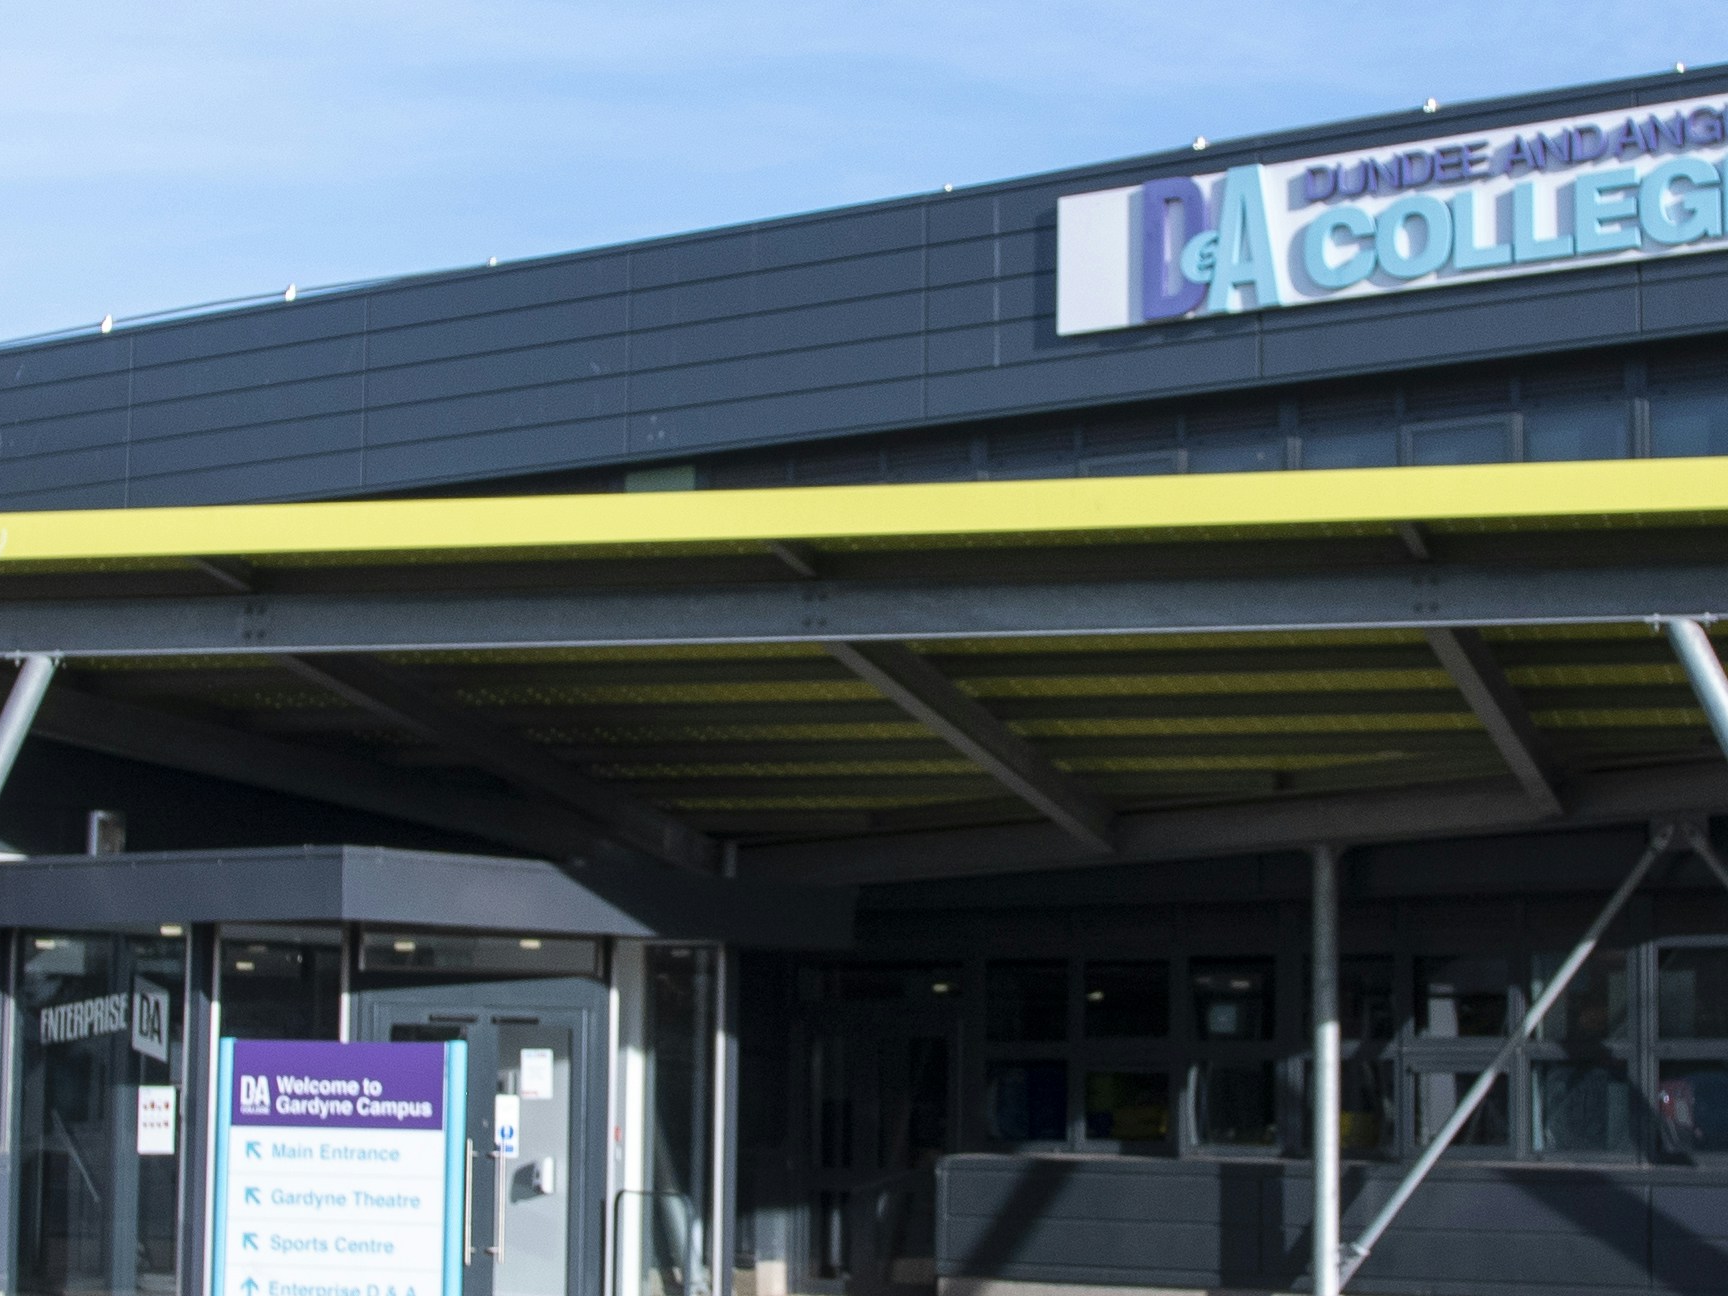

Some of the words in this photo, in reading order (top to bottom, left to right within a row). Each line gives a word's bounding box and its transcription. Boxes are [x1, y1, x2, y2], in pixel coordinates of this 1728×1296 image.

[1304, 139, 1490, 203] DUNDEE
[1504, 121, 1610, 173] AND
[40, 991, 129, 1045] ENTERPRISE
[276, 1075, 360, 1096] Welcome
[362, 1077, 383, 1097] to
[275, 1095, 354, 1119] Gardyne
[356, 1096, 433, 1121] Campus
[271, 1143, 314, 1159] Main
[319, 1144, 401, 1161] Entrance
[271, 1188, 347, 1211] Gardyne
[353, 1191, 421, 1209] Theatre
[269, 1235, 328, 1253] Sports
[334, 1237, 395, 1254] Centre
